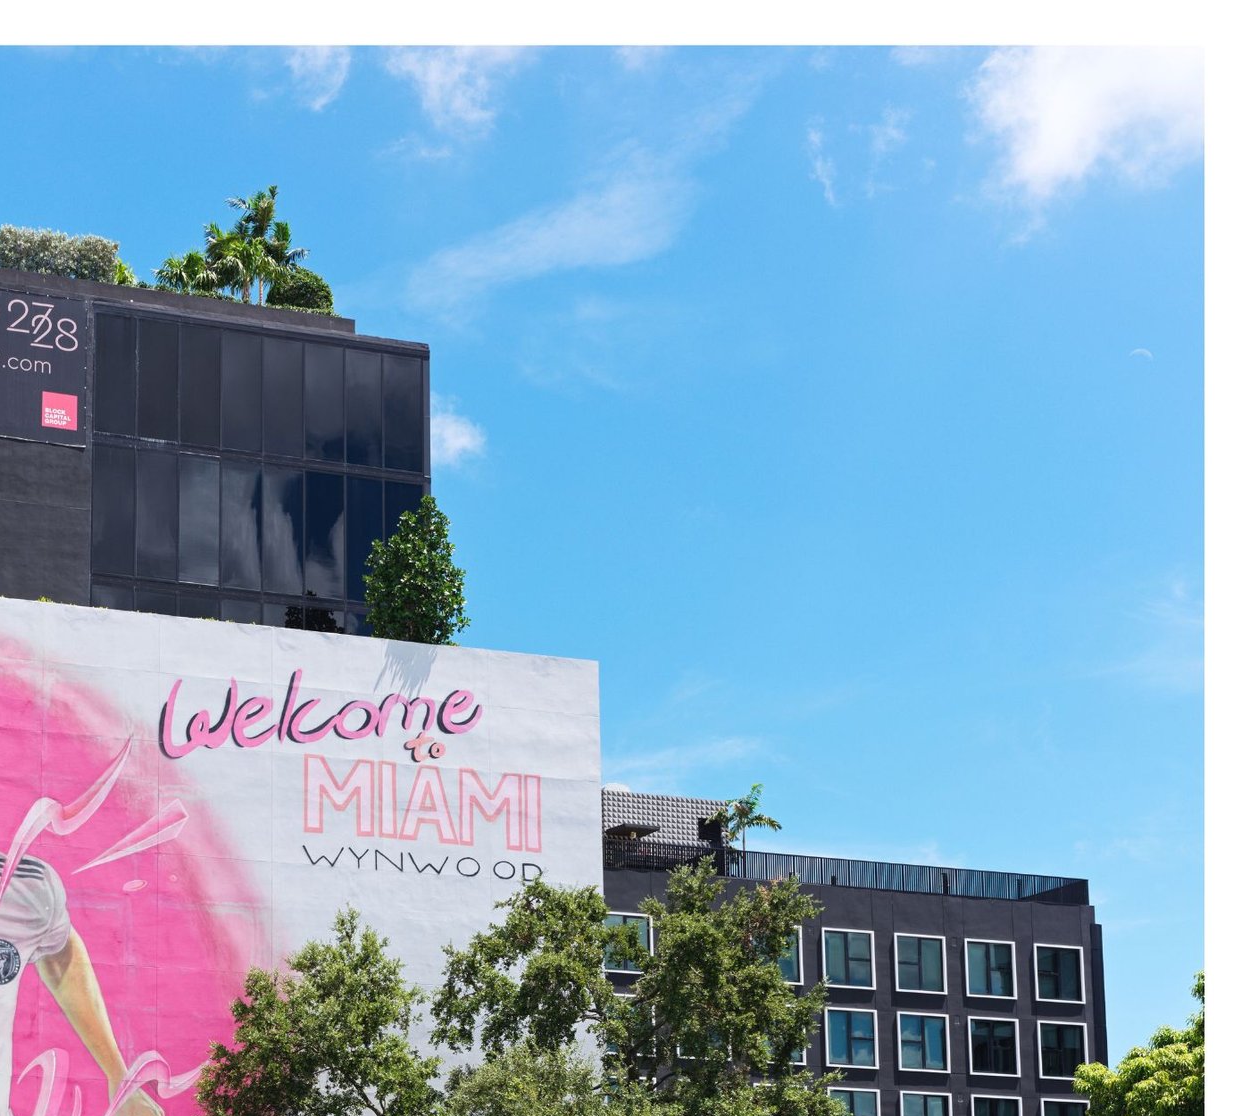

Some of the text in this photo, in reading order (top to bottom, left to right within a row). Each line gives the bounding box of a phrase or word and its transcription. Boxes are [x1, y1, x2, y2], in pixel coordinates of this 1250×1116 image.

[44, 418, 67, 426] GROUP
[45, 407, 66, 415] BLOCK
[45, 413, 72, 422] CAPITAL
[159, 668, 483, 760] Welcome
[403, 731, 447, 763] to
[303, 753, 542, 853] MIAMI
[302, 844, 543, 882] WYNWOOD
